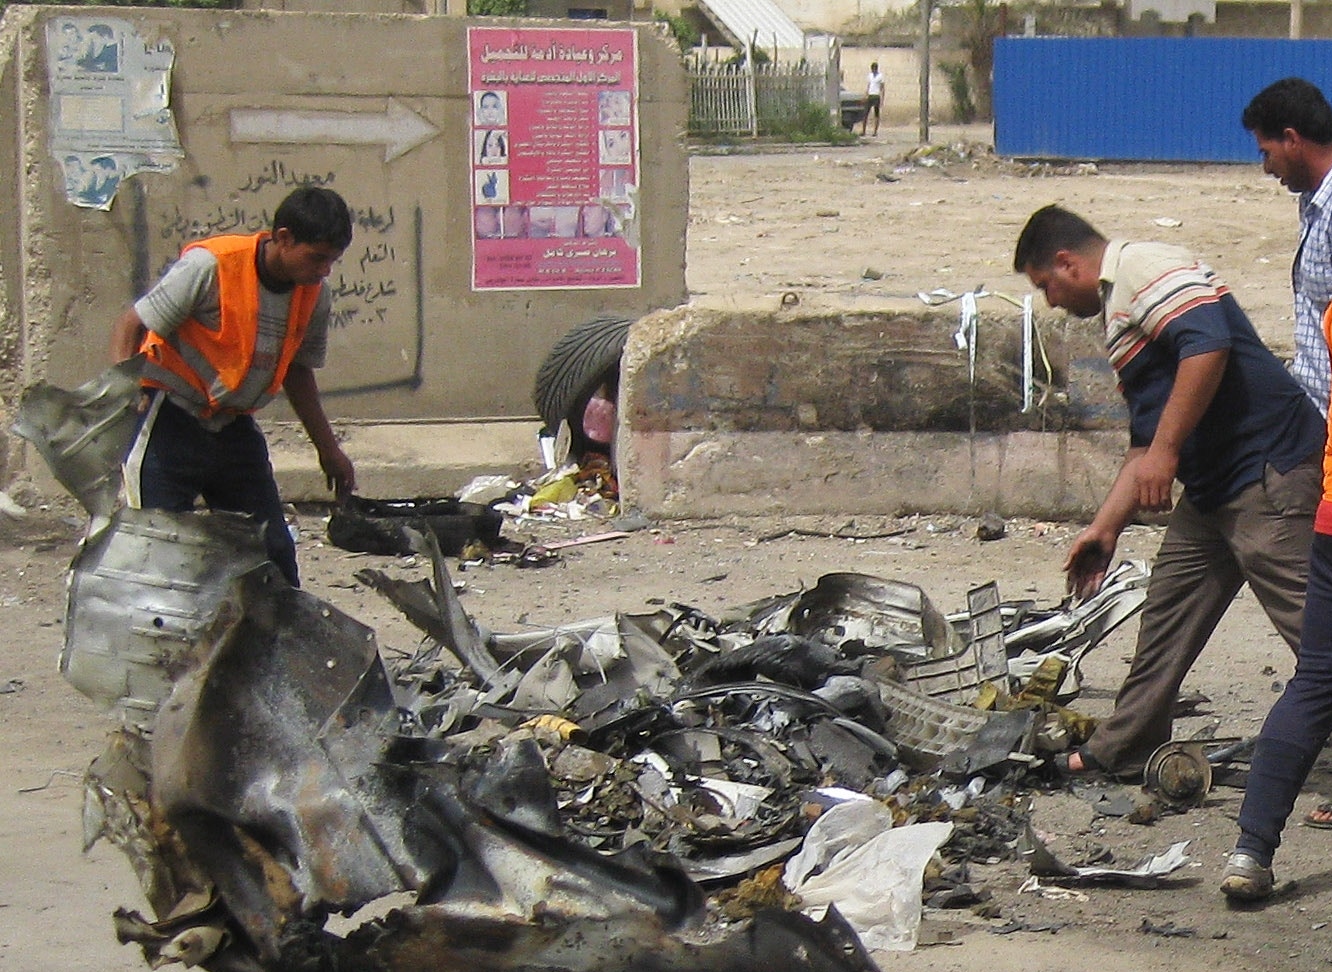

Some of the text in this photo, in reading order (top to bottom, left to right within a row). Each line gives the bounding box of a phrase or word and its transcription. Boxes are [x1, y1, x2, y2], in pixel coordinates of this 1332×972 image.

[480, 43, 528, 64] للتجميل
[559, 45, 594, 65] وعيادة
[597, 43, 624, 64] مركز
[238, 159, 336, 193] معهد النور
[360, 243, 396, 273] التعلم
[331, 273, 397, 304] شارع فلسطي
